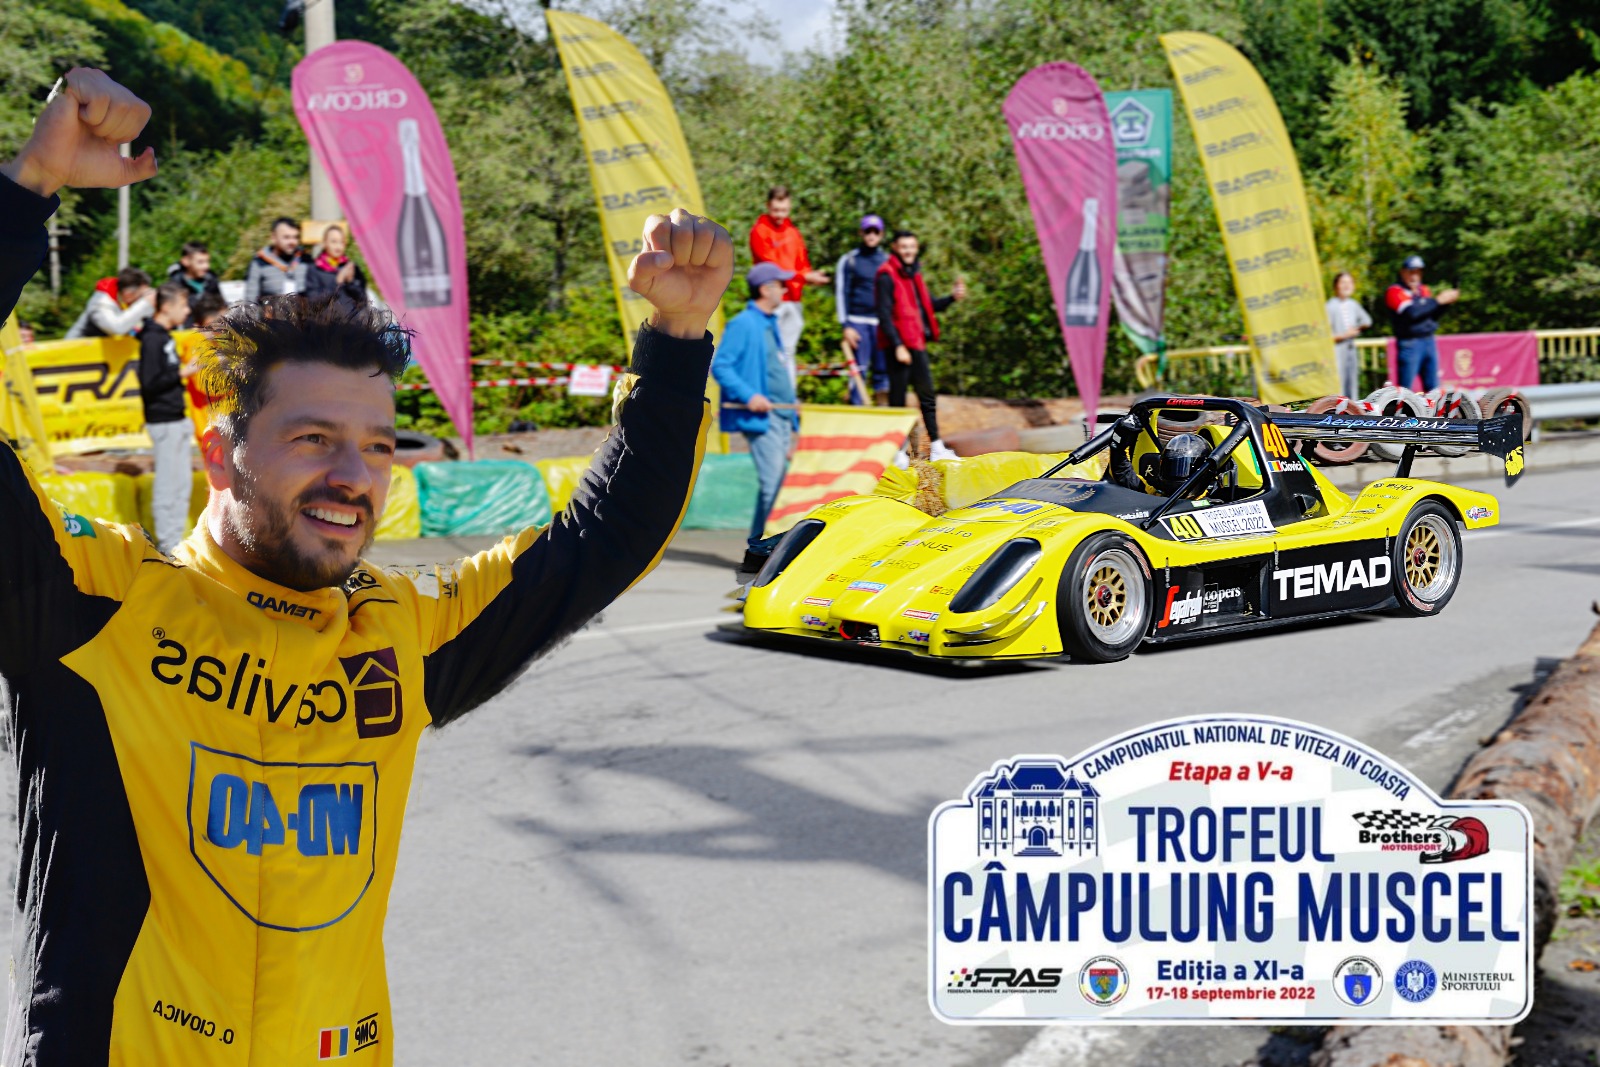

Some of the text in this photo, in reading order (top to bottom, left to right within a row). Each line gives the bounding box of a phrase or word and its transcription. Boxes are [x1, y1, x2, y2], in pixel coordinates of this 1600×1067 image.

[31, 361, 142, 403] FRA
[1261, 423, 1290, 459] 40
[1169, 515, 1203, 539] 40
[1209, 516, 1268, 534] MUSCEL 2022
[1273, 556, 1391, 601] TEMAD
